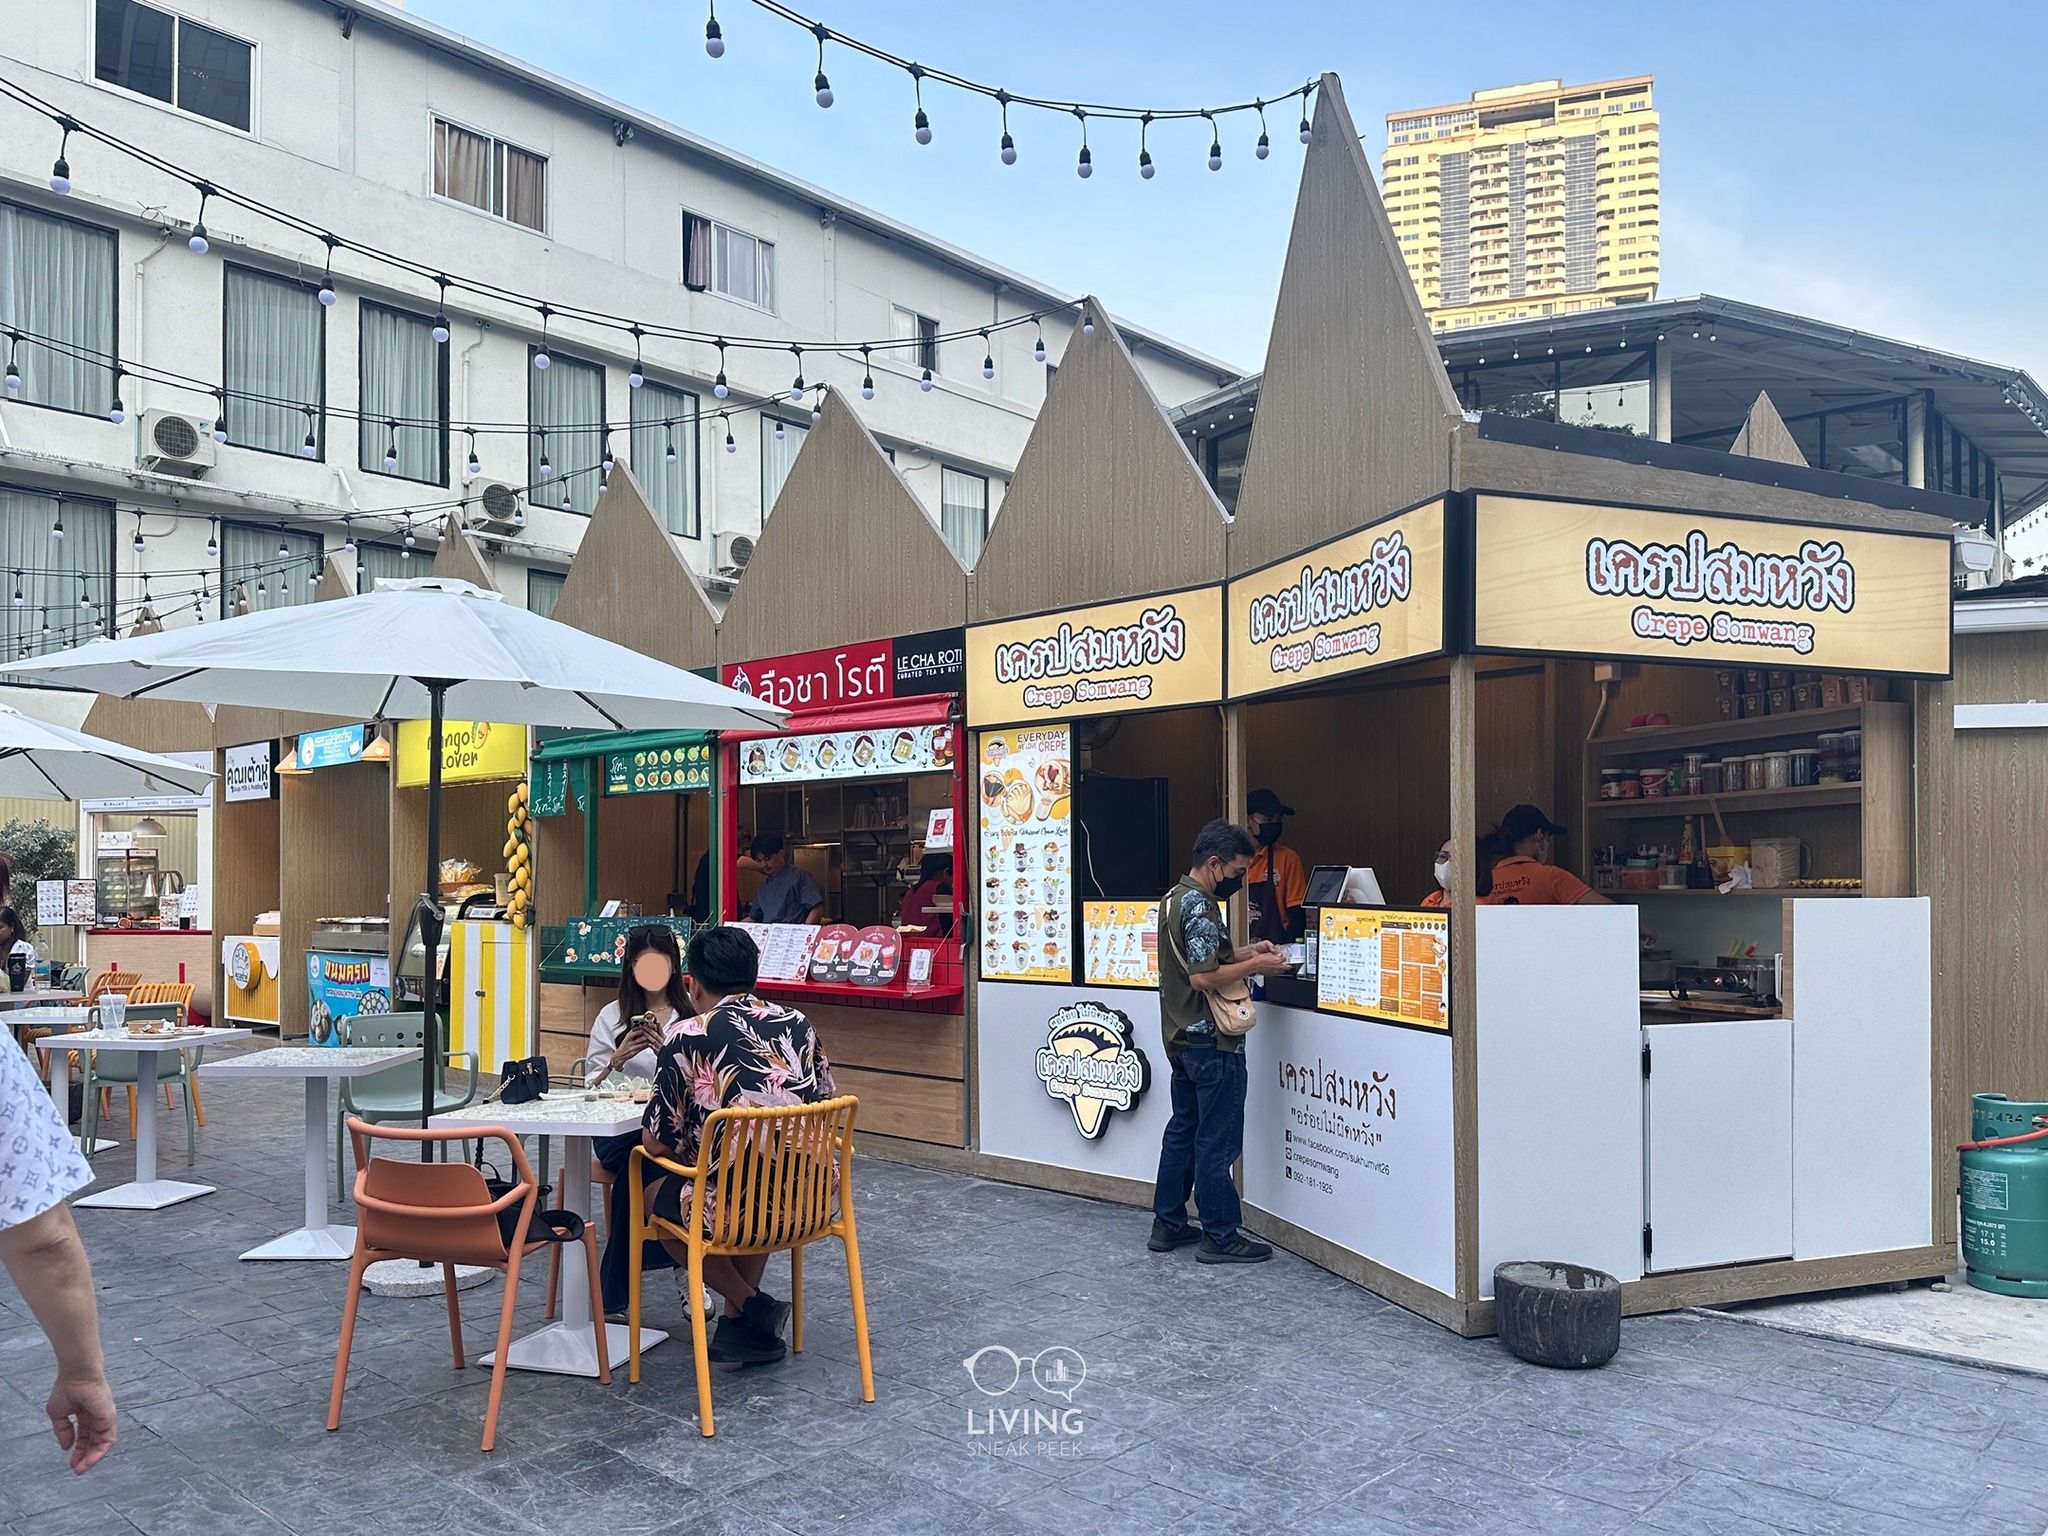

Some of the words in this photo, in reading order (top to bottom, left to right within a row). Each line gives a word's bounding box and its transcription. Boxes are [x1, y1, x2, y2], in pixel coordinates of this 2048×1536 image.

[1252, 535, 1408, 640] เครปสมหวัง
[1591, 534, 1851, 608] เครปสมหวัง
[998, 608, 1182, 680] เครปสมหวัง
[1634, 608, 1708, 643] Crepe
[1713, 614, 1812, 651] Somwang
[897, 655, 909, 671] LE
[910, 652, 936, 668] CHA
[938, 648, 963, 664] ROTI
[1273, 643, 1311, 670] Crepe
[1315, 625, 1379, 659] Somwang
[758, 669, 828, 706] ลือชา
[834, 653, 887, 699] โรตี
[896, 670, 923, 680] CURATED
[926, 668, 937, 676] TEA
[1025, 686, 1072, 706] Crepe
[1077, 676, 1151, 698] Somwang
[427, 732, 470, 755] ngo
[1017, 730, 1067, 743] EVERYDAY
[1025, 742, 1037, 750] LOVE
[1038, 740, 1067, 752] CREPE
[227, 754, 269, 792] คุณเต้าหู้
[325, 959, 370, 984] ขนมครก
[1039, 1050, 1139, 1088] เครปสมหวัง
[1050, 1080, 1079, 1095] Crepe
[1082, 1083, 1128, 1106] Somwang
[1279, 1057, 1396, 1120] เครปสมหวัง
[1291, 1104, 1382, 1147] "อร่อยไม่ผิดหวัง"
[1293, 1134, 1390, 1176] www.facebook.com/sukhumvit26
[1293, 1151, 1339, 1179] crepesomwang
[1293, 1171, 1334, 1195] 092-181-1925
[1980, 1238, 1996, 1247] 15.0
